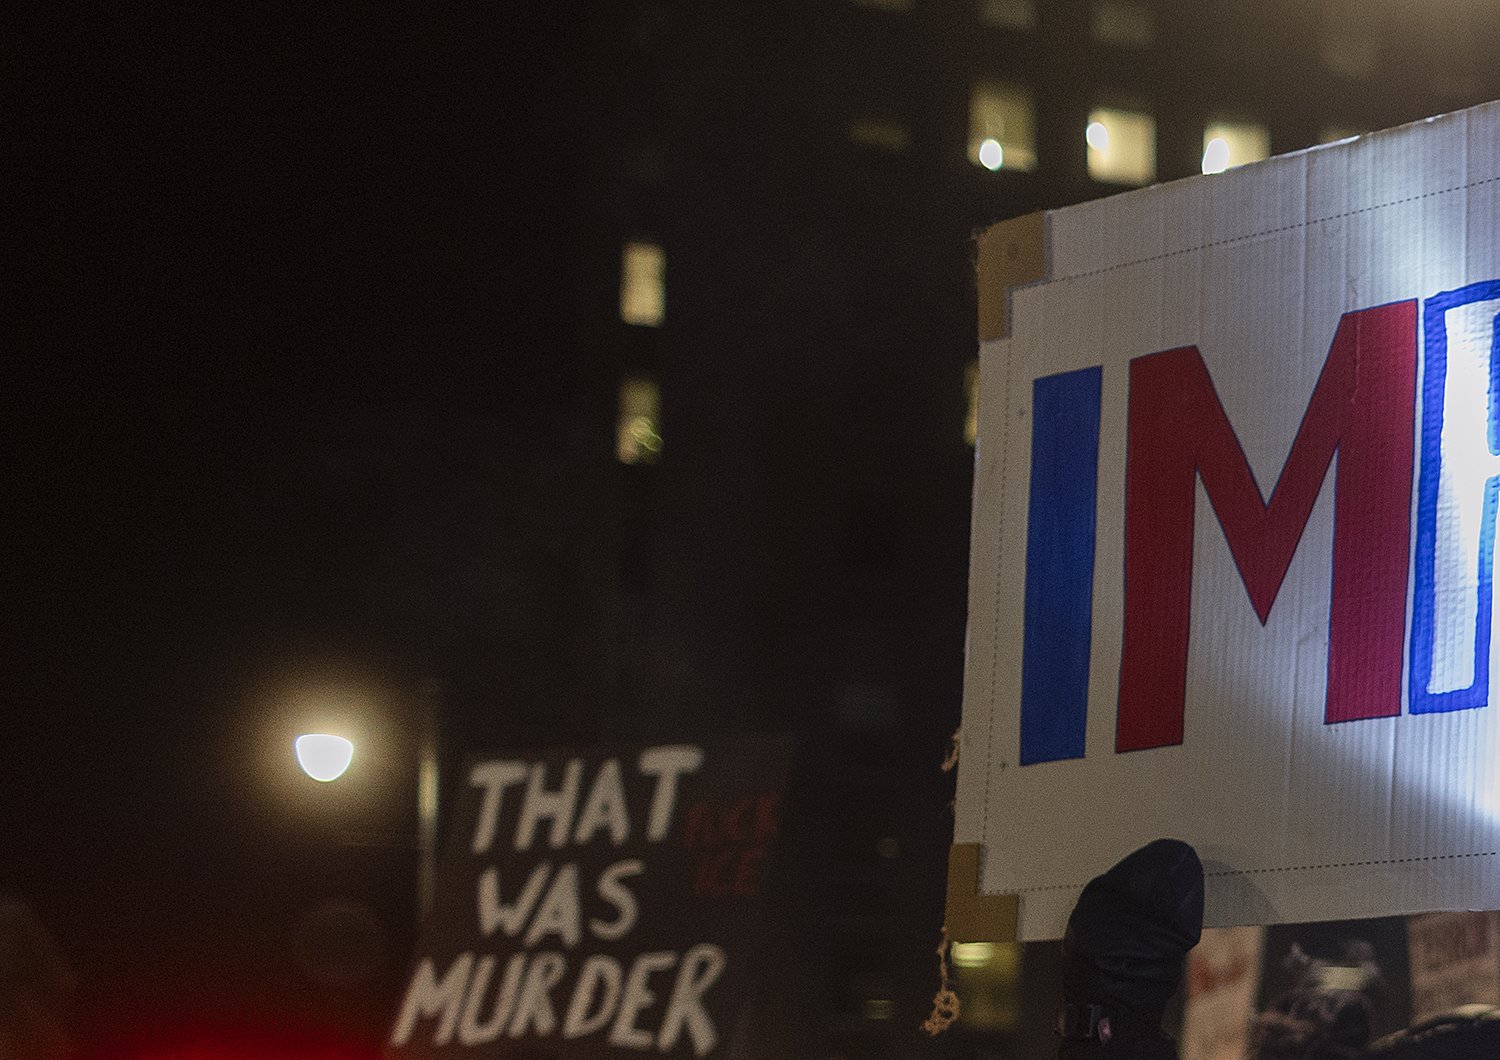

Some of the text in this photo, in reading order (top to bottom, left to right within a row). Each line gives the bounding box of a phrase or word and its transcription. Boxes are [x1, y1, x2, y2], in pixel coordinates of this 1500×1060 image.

[468, 744, 705, 853] THAT
[477, 858, 647, 949] WAS
[389, 942, 728, 1057] MURDER
